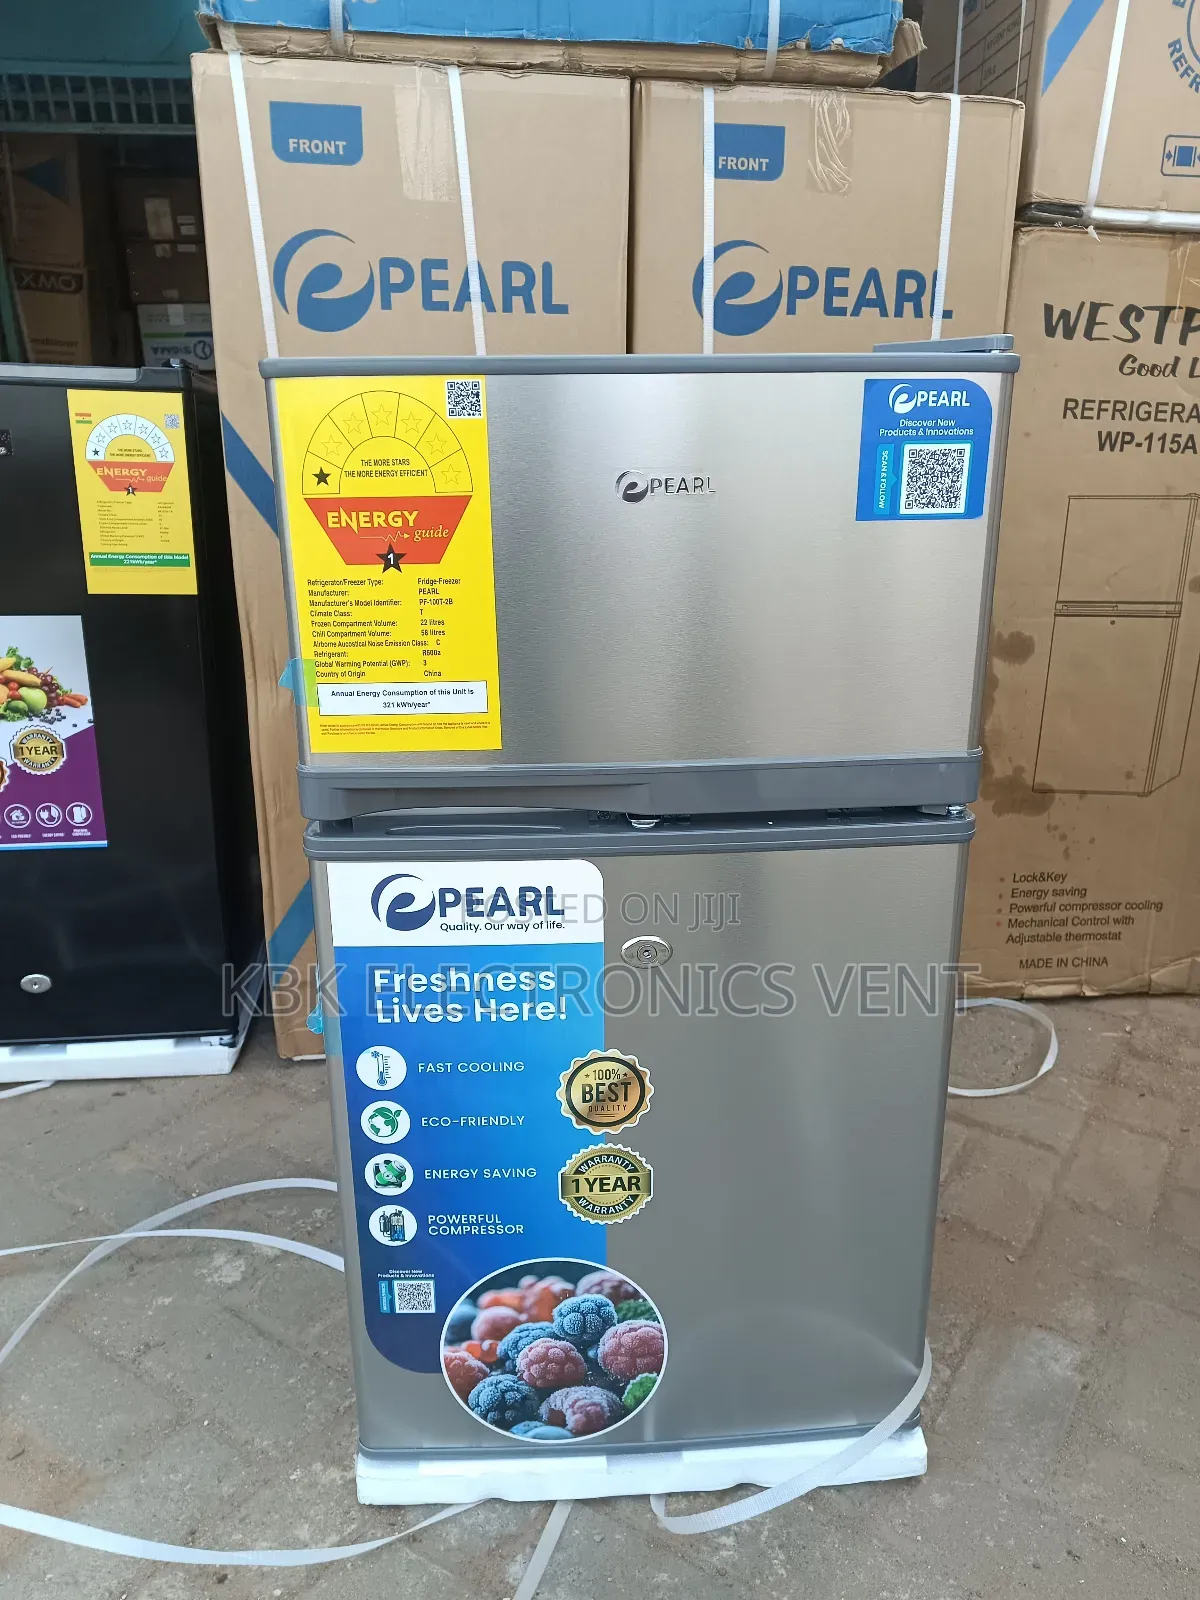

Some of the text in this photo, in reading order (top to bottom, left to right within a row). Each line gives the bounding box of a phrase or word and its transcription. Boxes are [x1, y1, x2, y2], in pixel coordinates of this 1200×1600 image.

[288, 138, 347, 155] FRONT
[718, 156, 769, 171] FRONT
[379, 257, 569, 315] PEARL
[786, 265, 953, 319] PEARL
[1119, 354, 1181, 377] Good
[917, 390, 970, 407] PEARL
[1062, 398, 1200, 423] REFRIGERA
[900, 419, 936, 427] Discover
[880, 427, 974, 436] Products & Innovations
[1098, 431, 1198, 455] WP-115A
[392, 458, 410, 466] STARS
[881, 450, 889, 472] SCAN
[96, 466, 148, 478] ENERGY
[344, 470, 356, 478] THE
[356, 470, 374, 478] MORE
[375, 470, 398, 478] ENERGY
[650, 476, 716, 496] PEARL
[879, 478, 888, 509] FOLLOW
[327, 507, 419, 534] ENERGY
[413, 525, 449, 542] guide
[387, 553, 394, 565] 1
[367, 579, 384, 587] Type:
[418, 578, 461, 586] Fridge-Freezer
[332, 620, 372, 628] Compartment
[326, 630, 366, 638] Compartment
[314, 651, 348, 659] Refrigerant:
[389, 660, 410, 668] (GWP):
[356, 690, 380, 698] Energy
[382, 690, 428, 698] Consumption
[19, 746, 58, 756] 1 YEAR
[1013, 871, 1068, 884] Lock&Key
[1011, 886, 1087, 900] Energy saving
[438, 886, 564, 917] PEARL
[1010, 900, 1163, 913] Powerful compressor cooling
[440, 920, 565, 933] Quality. Our way of life.
[1008, 915, 1134, 928] Mechanical Control with
[1006, 930, 1122, 945] Adjustable thermostat
[1019, 957, 1109, 969] MADE IN CHINA
[374, 968, 556, 993] Freshness
[376, 996, 567, 1024] Lives Here!
[418, 1061, 525, 1073] FAST COOLING
[593, 1069, 621, 1080] 100%
[582, 1082, 631, 1103] BEST
[421, 1115, 525, 1127] ECO-FRIENDLY
[579, 1155, 634, 1173] WARRANTY
[424, 1167, 537, 1180] ENERGY SAVING
[572, 1176, 641, 1193] 1 YEAR
[579, 1195, 634, 1214] WARRANTY
[428, 1214, 501, 1225] POWERFUL
[428, 1224, 524, 1236] COMPRESSOR
